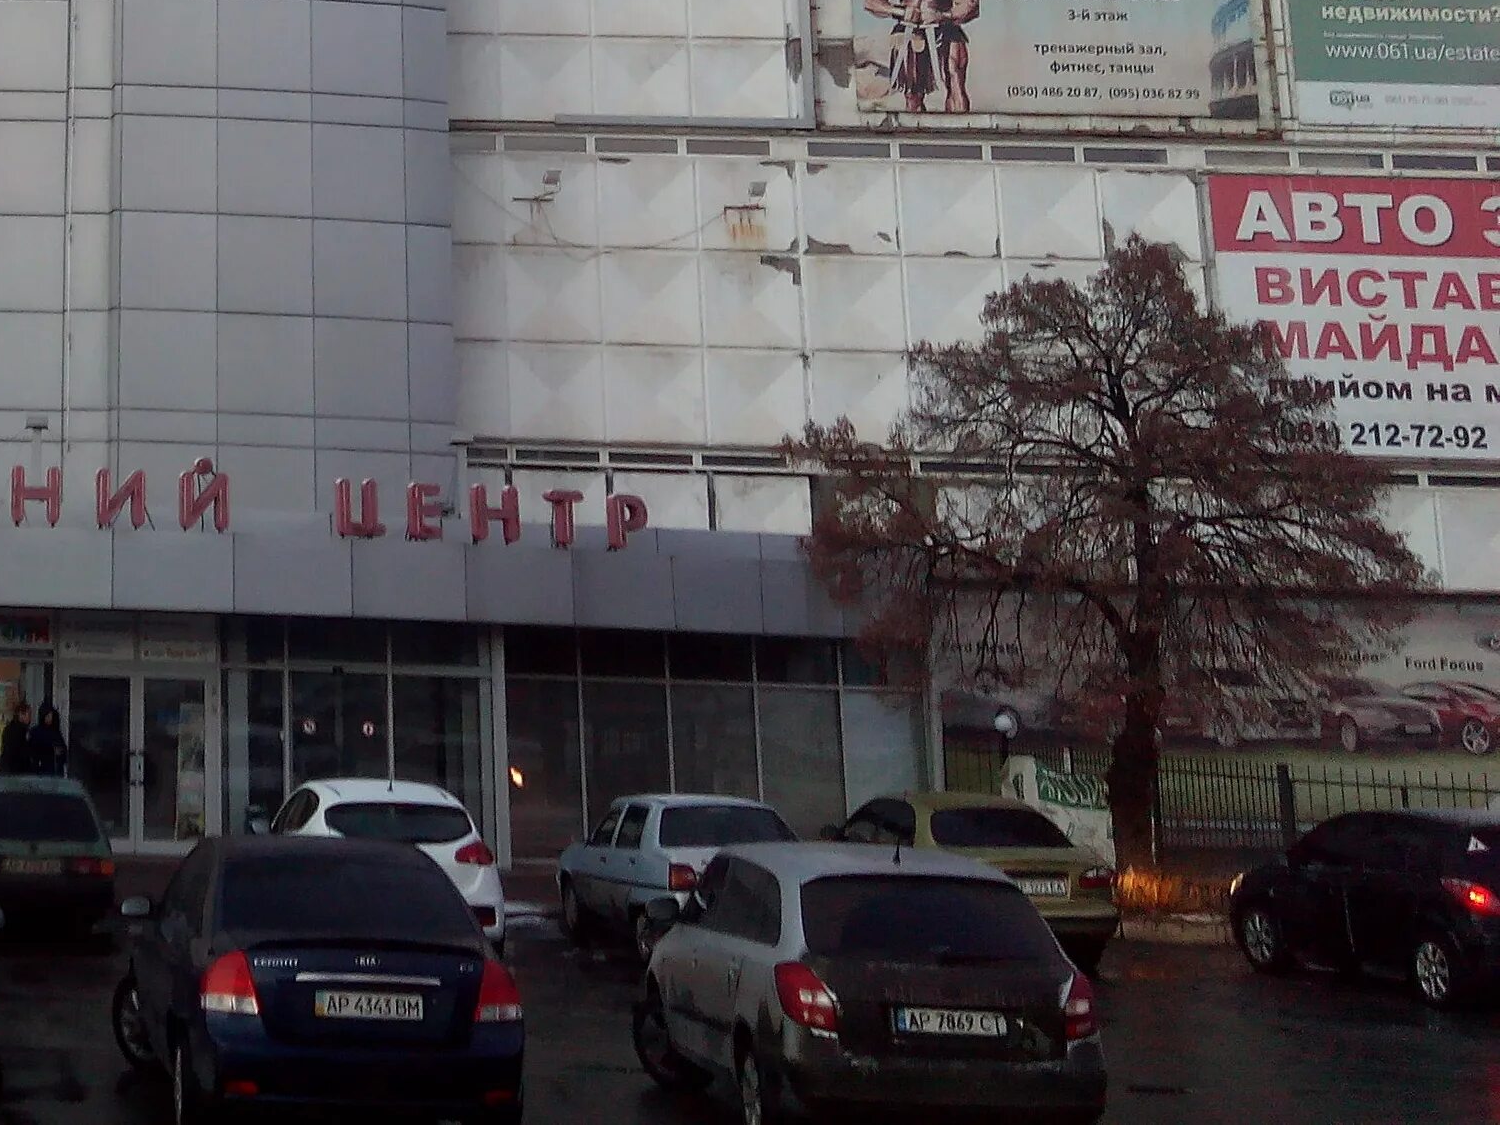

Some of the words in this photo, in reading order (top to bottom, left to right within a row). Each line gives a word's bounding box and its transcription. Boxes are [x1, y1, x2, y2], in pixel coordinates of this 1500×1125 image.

[1068, 8, 1090, 22] 3-й
[1095, 11, 1129, 23] этаж
[1033, 42, 1136, 57] тренажерный
[1139, 43, 1168, 58] зал,
[1049, 61, 1106, 76] фитнес,
[1108, 62, 1155, 75] танцы
[1007, 85, 1039, 100] (050)
[1066, 86, 1082, 99] 20
[1108, 86, 1140, 101] (095)
[1142, 87, 1165, 100] 036
[1235, 190, 1453, 247] АВТО
[1426, 382, 1472, 403] на
[1350, 422, 1489, 450] 212-72-92
[335, 477, 650, 552] ЦЕНТР
[1405, 656, 1438, 671] Ford
[1440, 658, 1484, 673] Focus
